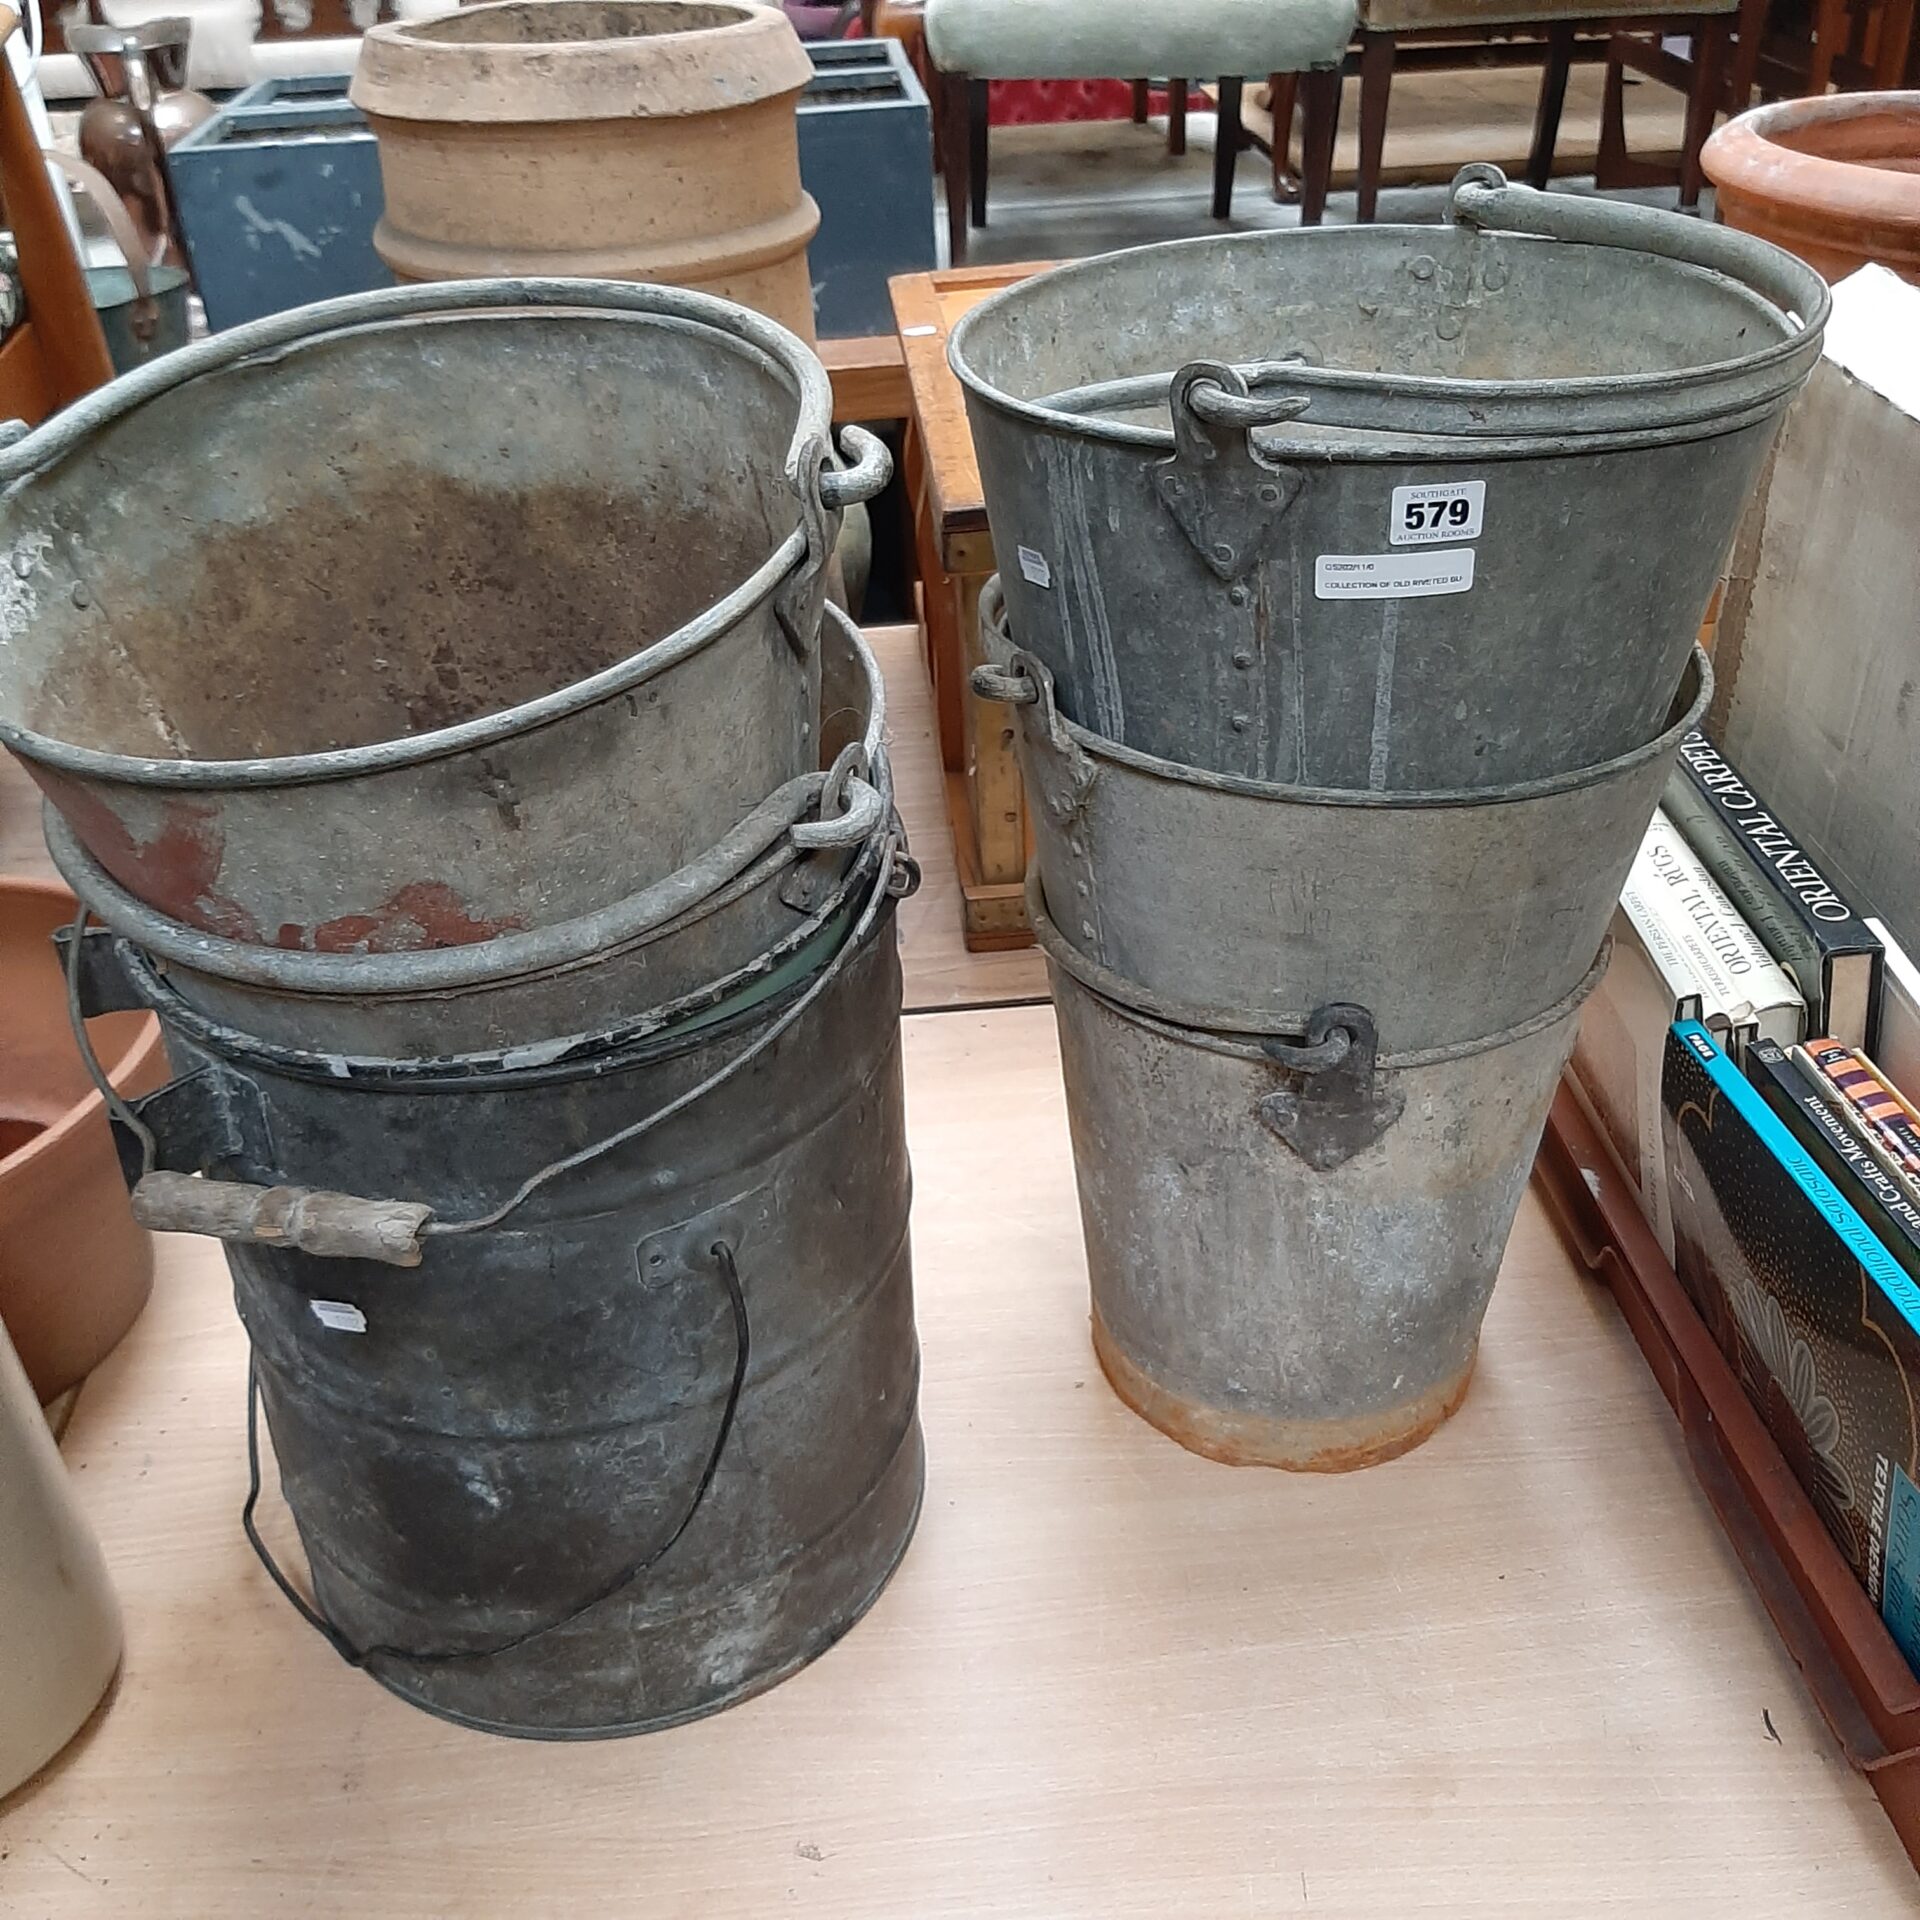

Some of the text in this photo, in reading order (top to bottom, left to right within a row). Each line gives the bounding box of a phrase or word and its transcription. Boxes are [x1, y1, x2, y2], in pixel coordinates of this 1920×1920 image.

[1404, 498, 1470, 530] 579
[1410, 487, 1467, 500] SOUTHGATE
[1396, 528, 1475, 542] AUCTION ROOMS
[1324, 581, 1378, 590] COLLECTION
[1393, 580, 1411, 588] OLD
[1680, 731, 1757, 810] CARPETS
[1736, 811, 1852, 923] ORIENTAL
[1681, 889, 1752, 975] ORIENTAL
[1688, 1034, 1715, 1058] PAGE
[1803, 1095, 1863, 1163] Movement
[1860, 1157, 1902, 1202] Crafts
[1869, 1452, 1889, 1536] TEXTILE
